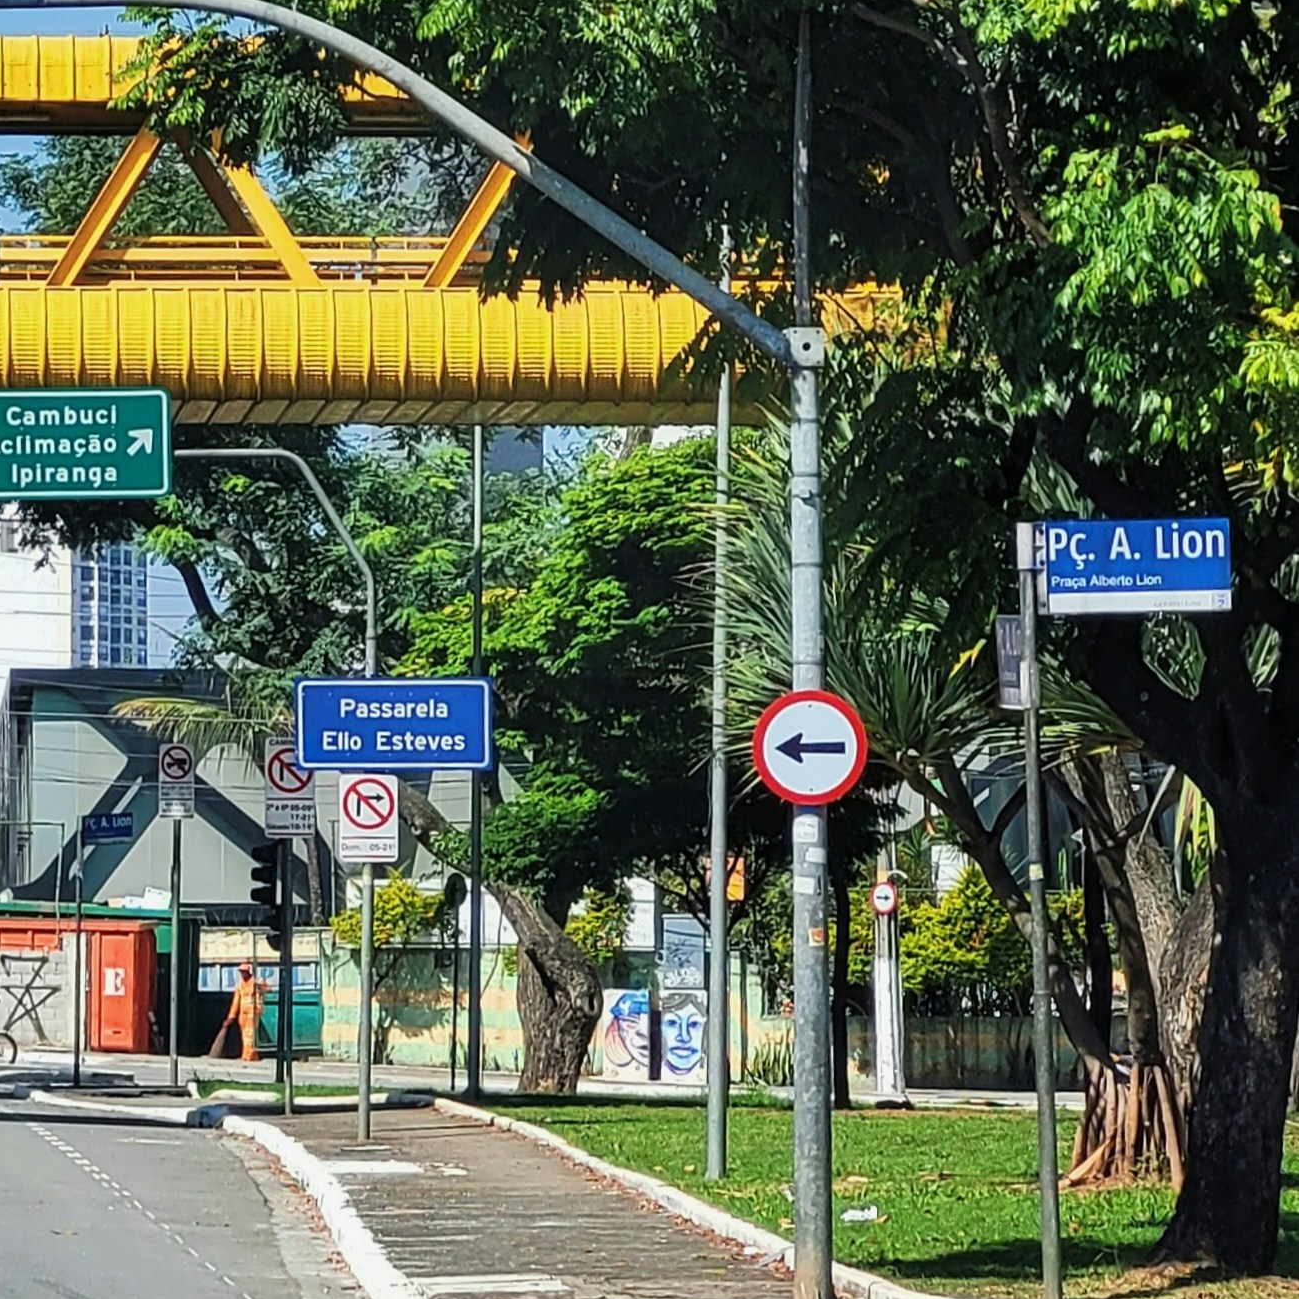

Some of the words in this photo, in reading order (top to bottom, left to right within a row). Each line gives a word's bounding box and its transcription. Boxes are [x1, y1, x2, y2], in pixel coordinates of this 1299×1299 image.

[6, 405, 117, 426] Cambuci
[11, 463, 117, 488] Ipiranga
[1050, 528, 1096, 570] Pç.
[1109, 526, 1141, 561] A.
[1155, 522, 1226, 560] Lion
[1051, 575, 1087, 589] Praça
[1089, 574, 1133, 587] Alberto
[1136, 573, 1162, 585] Lion
[339, 698, 449, 718] Passarela
[322, 731, 362, 751] Elio
[376, 731, 466, 751] Esteves
